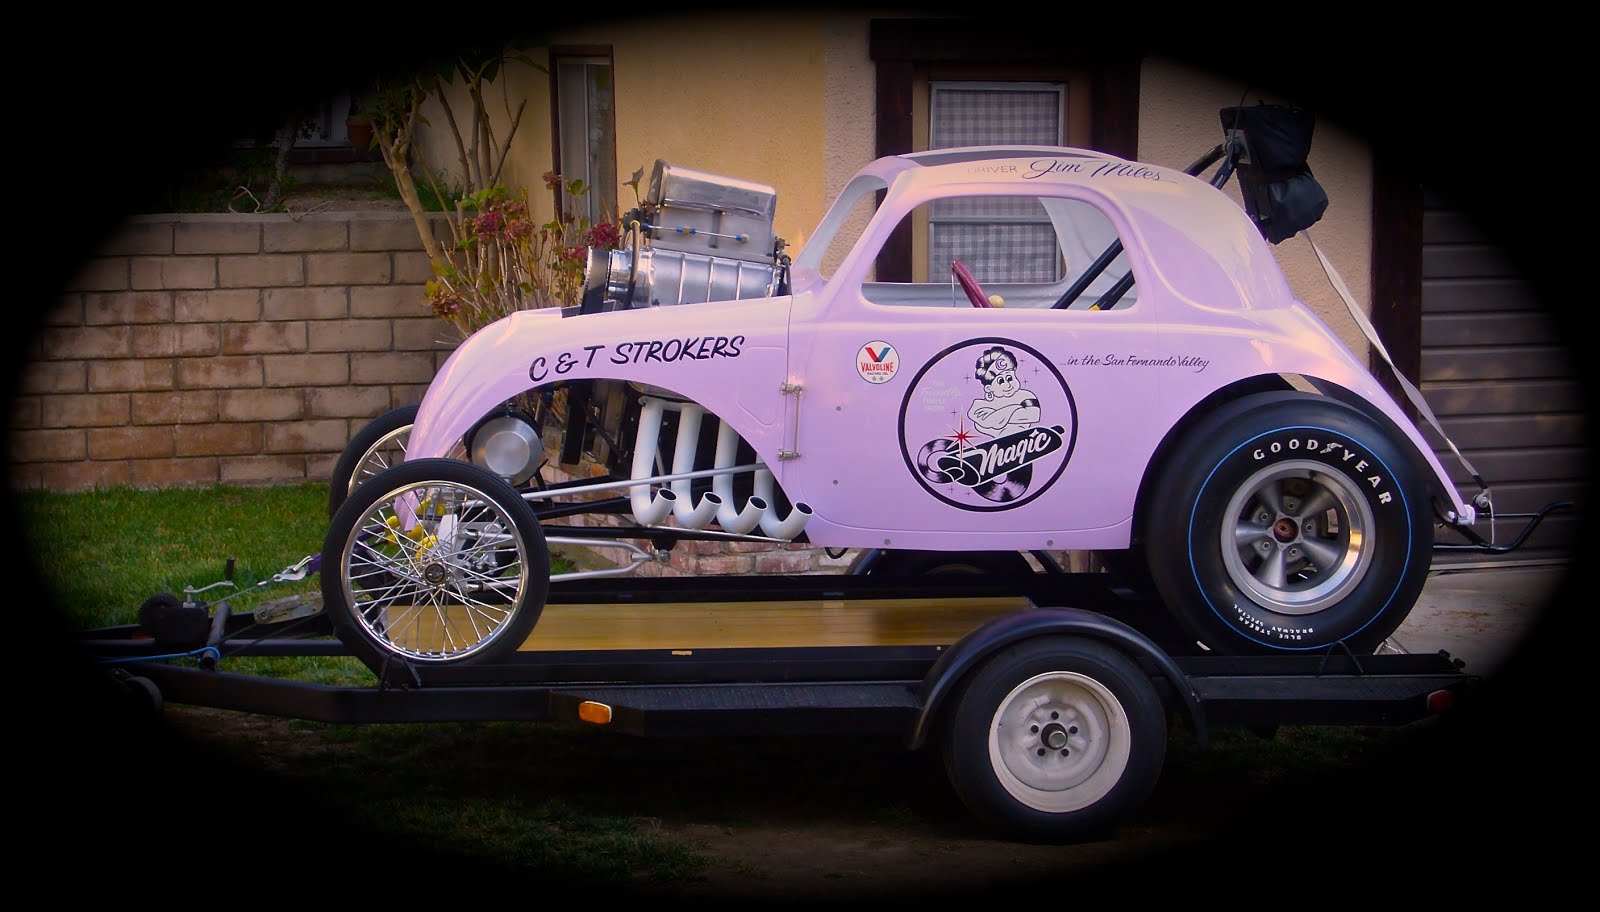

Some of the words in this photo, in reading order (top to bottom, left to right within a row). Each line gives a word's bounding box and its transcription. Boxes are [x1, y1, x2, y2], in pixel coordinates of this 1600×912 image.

[1022, 159, 1085, 180] Jim
[1087, 160, 1164, 182] Miles
[529, 356, 549, 382] C
[554, 352, 579, 374] &
[583, 344, 606, 368] T
[610, 335, 745, 365] STROKERS
[860, 361, 894, 372] VALVOLINE
[1081, 355, 1101, 366] the
[1102, 353, 1125, 366] San
[1126, 355, 1177, 367] Fernando
[1177, 355, 1210, 374] Valley
[958, 428, 1052, 476] Magic
[1233, 604, 1264, 627] SPECIAL
[1238, 616, 1271, 636] STREAK
[1271, 625, 1314, 634] DRAGWAY
